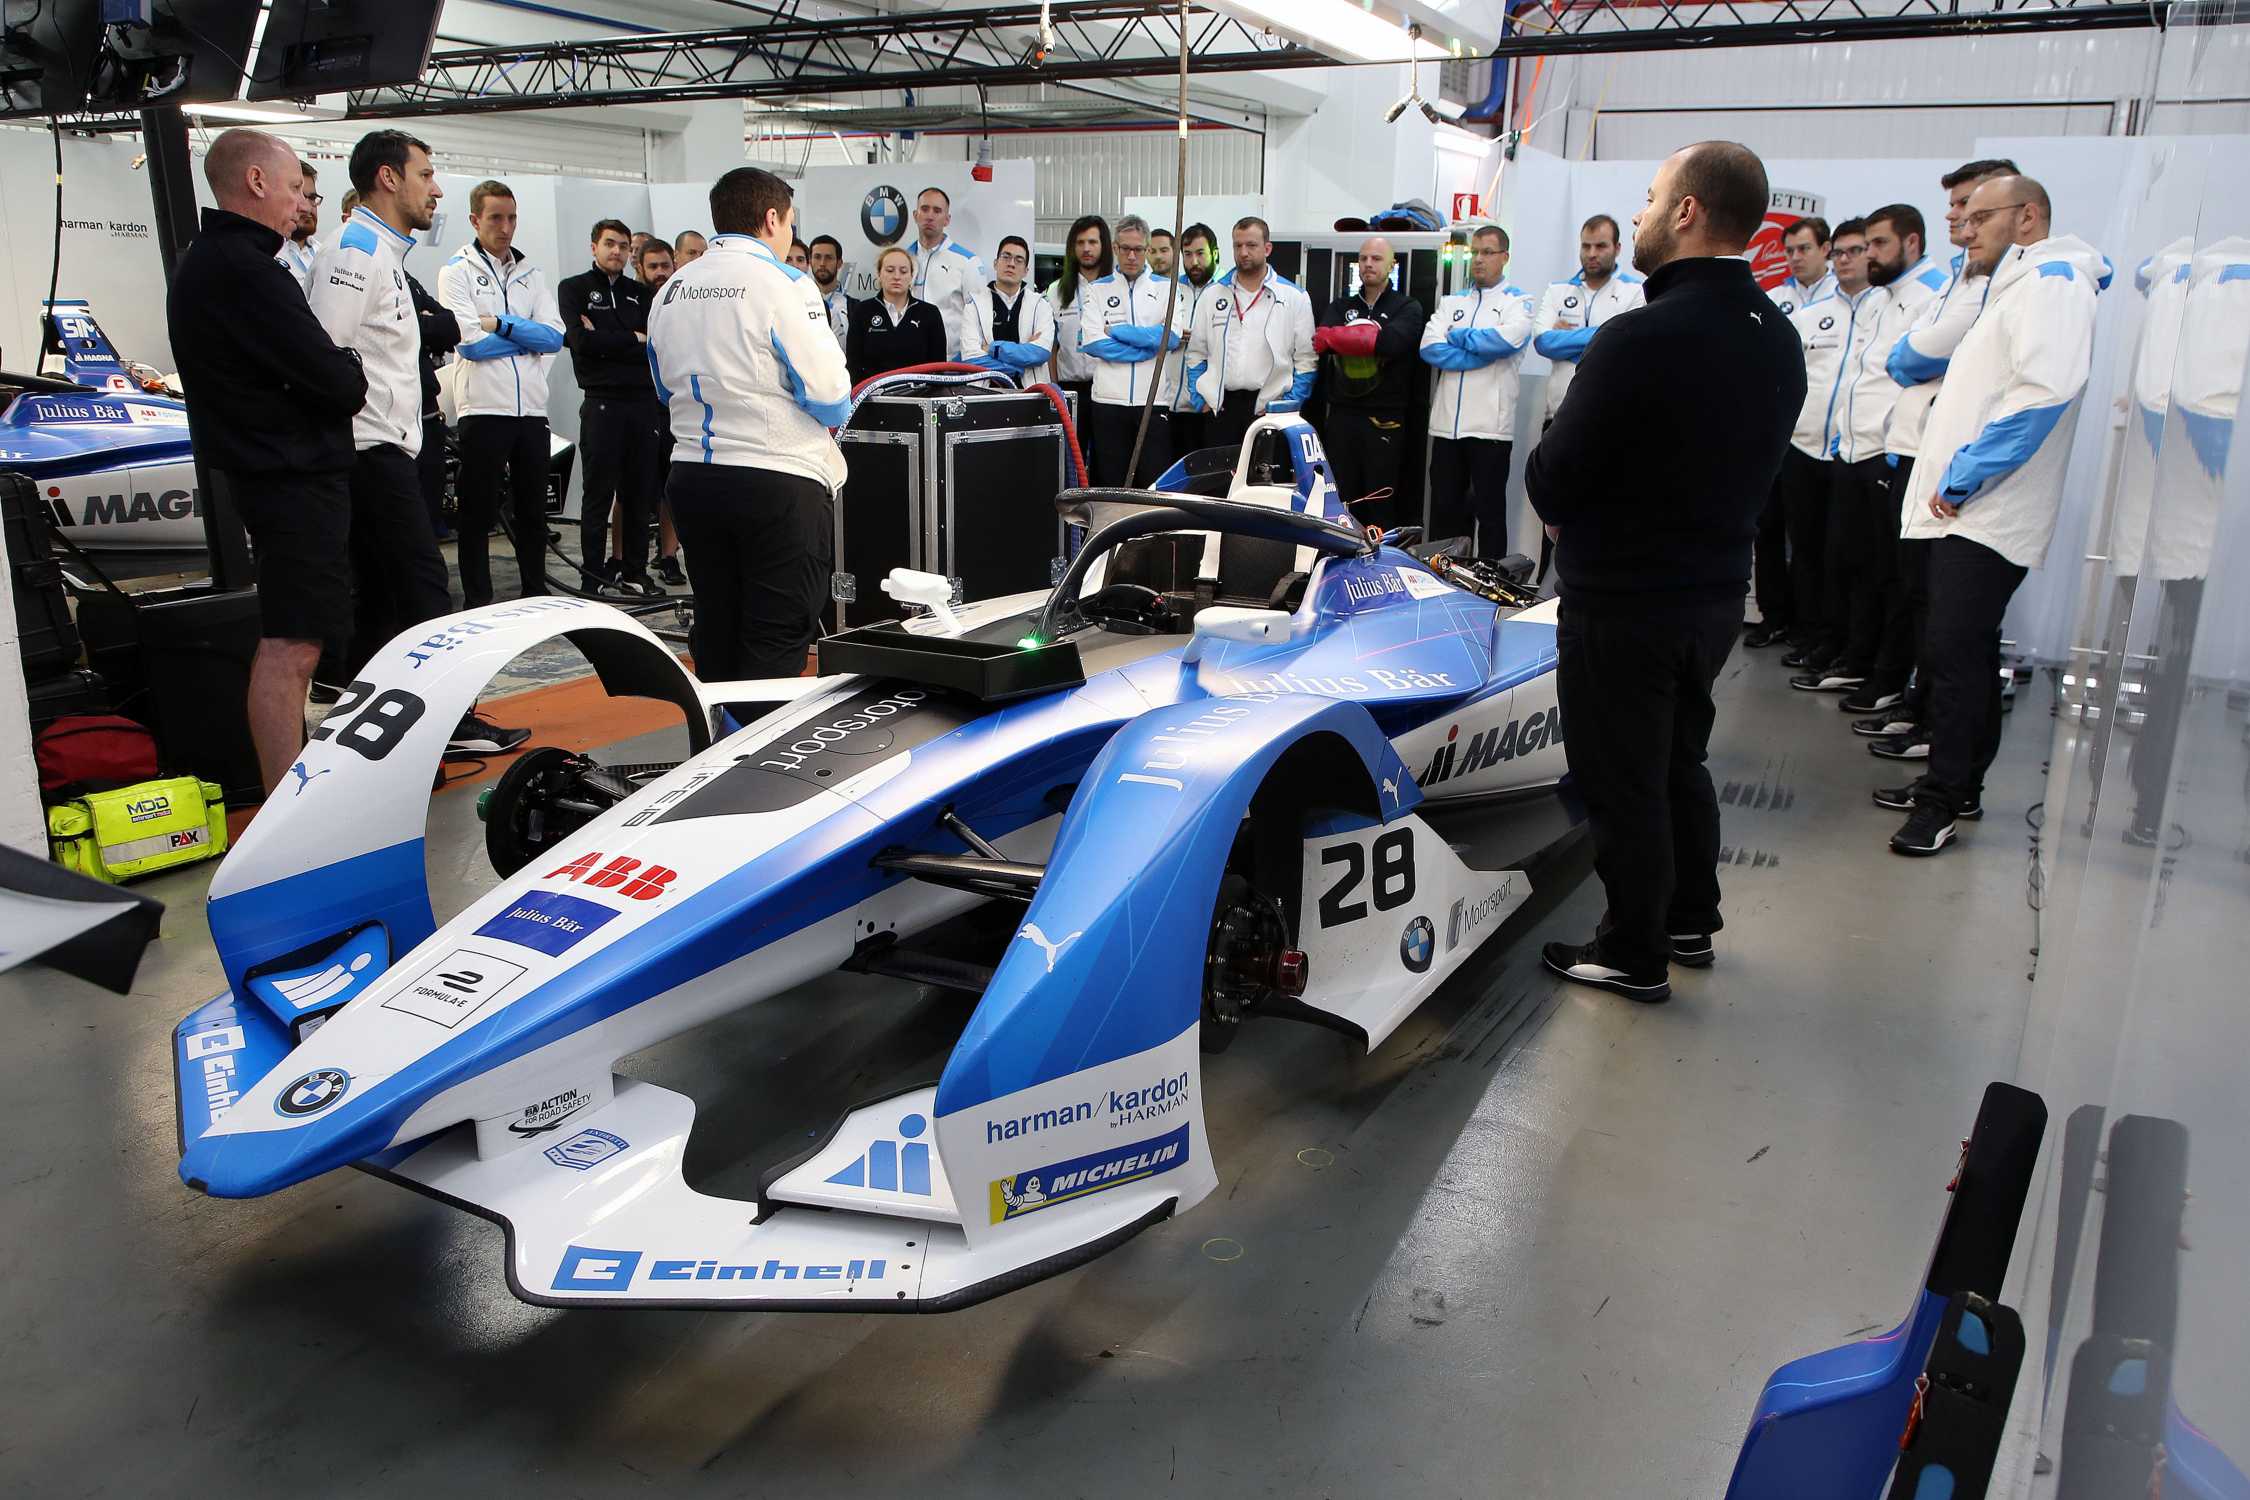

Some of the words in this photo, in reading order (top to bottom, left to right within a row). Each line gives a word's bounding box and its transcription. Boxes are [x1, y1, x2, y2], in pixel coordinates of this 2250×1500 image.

[1771, 193, 1816, 213] ETTI
[680, 286, 747, 303] Motorsport
[83, 354, 115, 362] MAGNA
[36, 403, 91, 420] Julius
[94, 405, 125, 419] Bär
[83, 490, 203, 526] MAG
[1344, 576, 1383, 606] Julius
[1382, 571, 1405, 596] Bär
[403, 620, 494, 670] Bär
[1364, 668, 1457, 691] Bär
[311, 680, 426, 761] 28
[760, 689, 927, 771] otorsport
[1117, 704, 1252, 792] Julius
[1453, 705, 1564, 778] MAGN
[170, 830, 199, 847] PAX
[541, 851, 677, 900] ABB
[1318, 826, 1417, 930] 28
[505, 907, 552, 925] Julius
[550, 916, 584, 934] Bär
[1463, 875, 1513, 934] Motorsport
[524, 1115, 538, 1125] FOR
[538, 1106, 561, 1121] ROAD
[562, 1093, 592, 1113] SAFETY
[540, 1089, 577, 1112] ACTION
[1118, 1090, 1190, 1127] HARMAN
[1050, 1141, 1180, 1194] MICHELIN
[648, 1258, 887, 1281] Einhell
